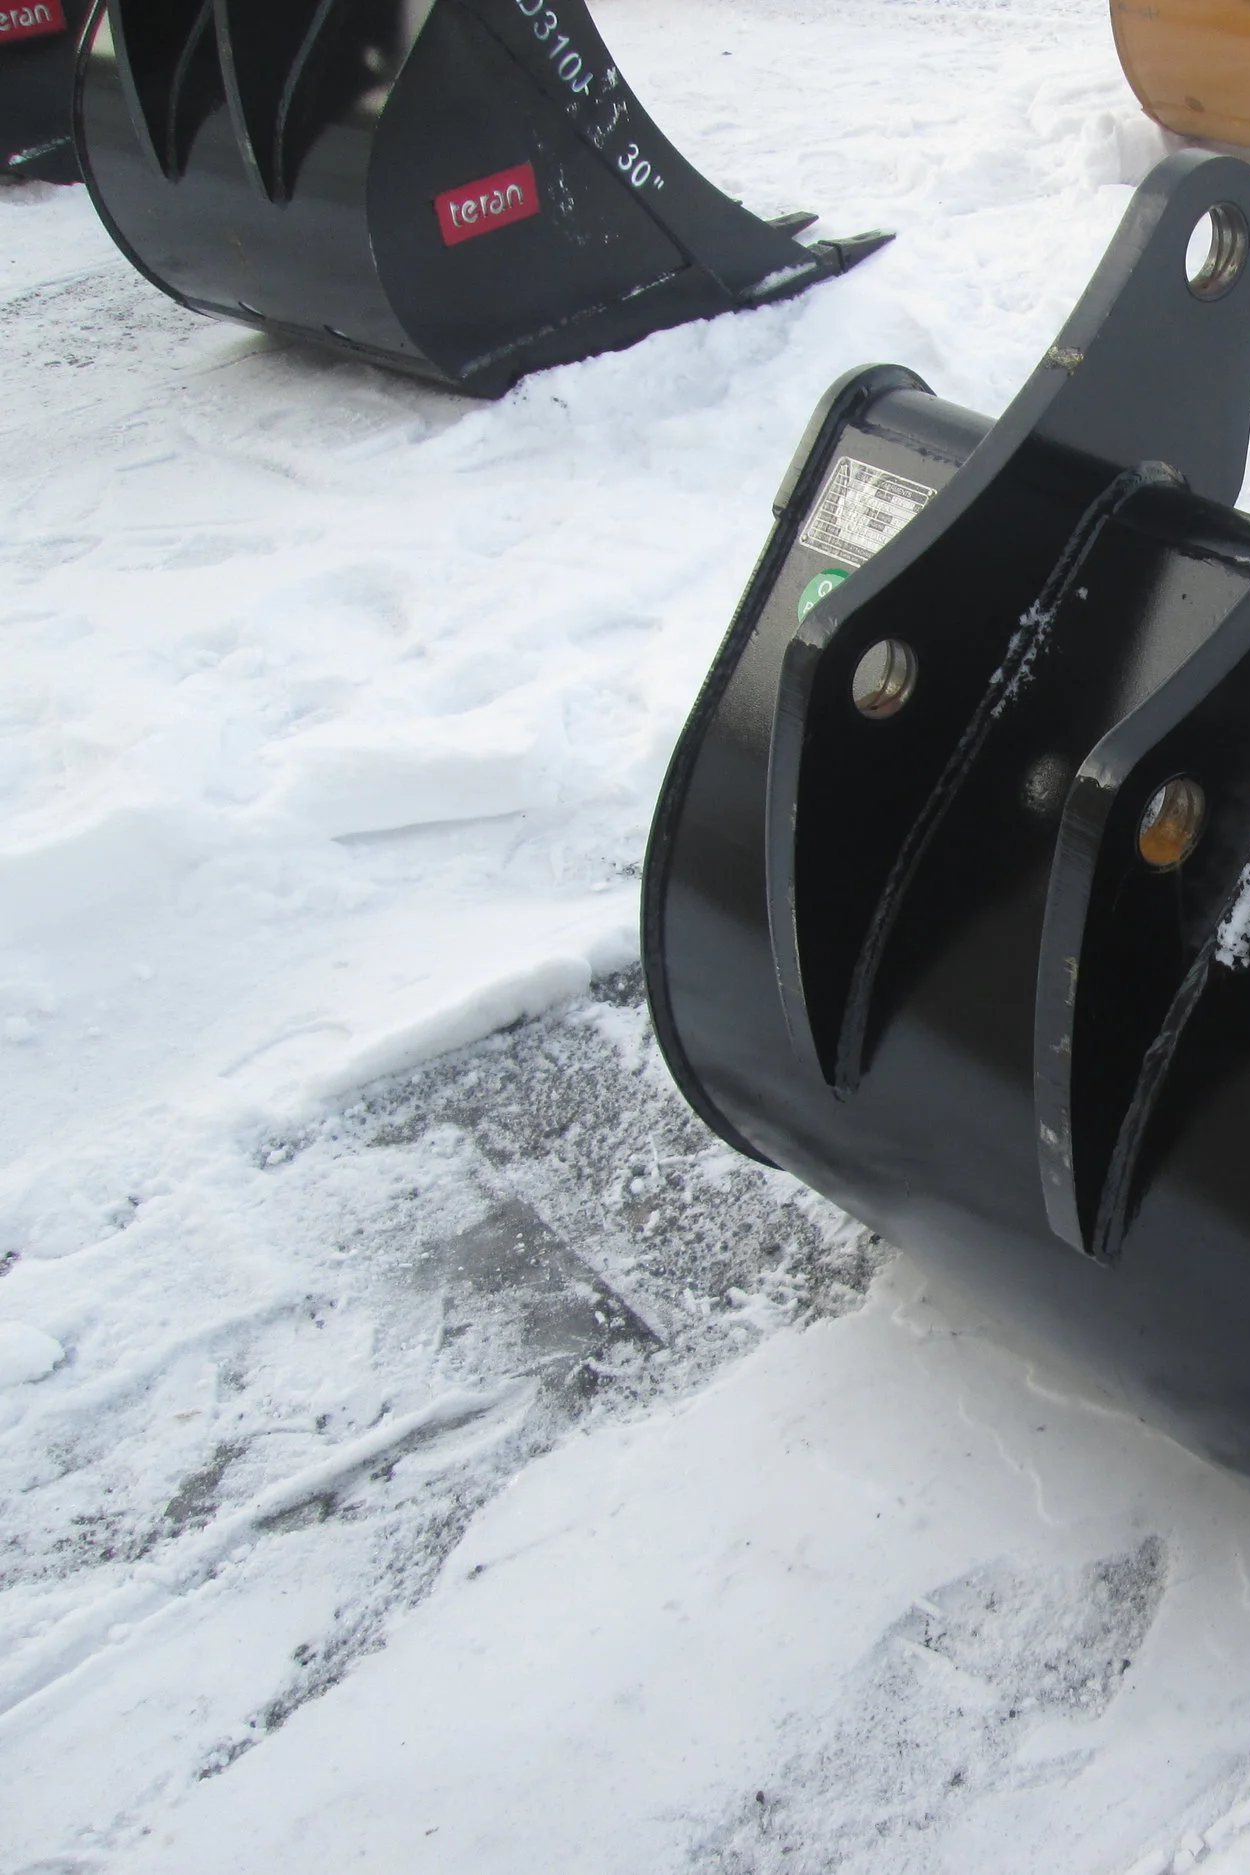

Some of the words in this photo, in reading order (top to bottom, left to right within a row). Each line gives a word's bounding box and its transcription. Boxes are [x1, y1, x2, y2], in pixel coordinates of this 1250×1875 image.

[0, 4, 52, 31] eran
[516, 0, 593, 95] D310J
[618, 143, 665, 190] 30"
[449, 184, 524, 228] teran
